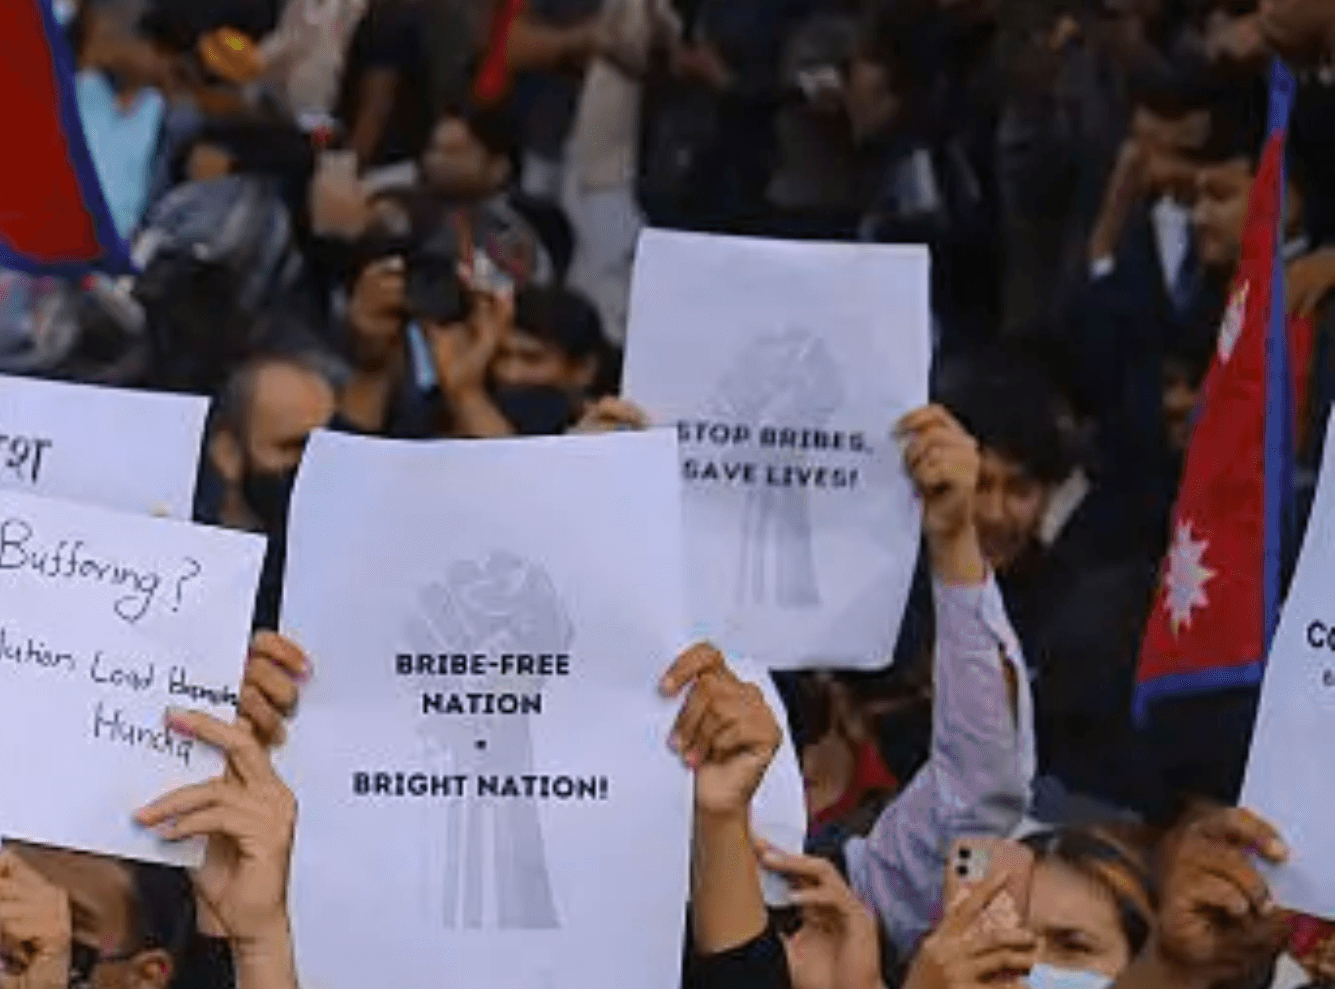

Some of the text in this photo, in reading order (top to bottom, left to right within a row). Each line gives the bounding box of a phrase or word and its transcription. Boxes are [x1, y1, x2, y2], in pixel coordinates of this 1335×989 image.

[677, 420, 750, 445] STOP
[683, 458, 859, 490] SAVE LIVES!
[396, 653, 570, 676] BRIBE-FREE
[422, 693, 542, 715] NATION
[353, 771, 609, 800] BRIGHT NATION!
